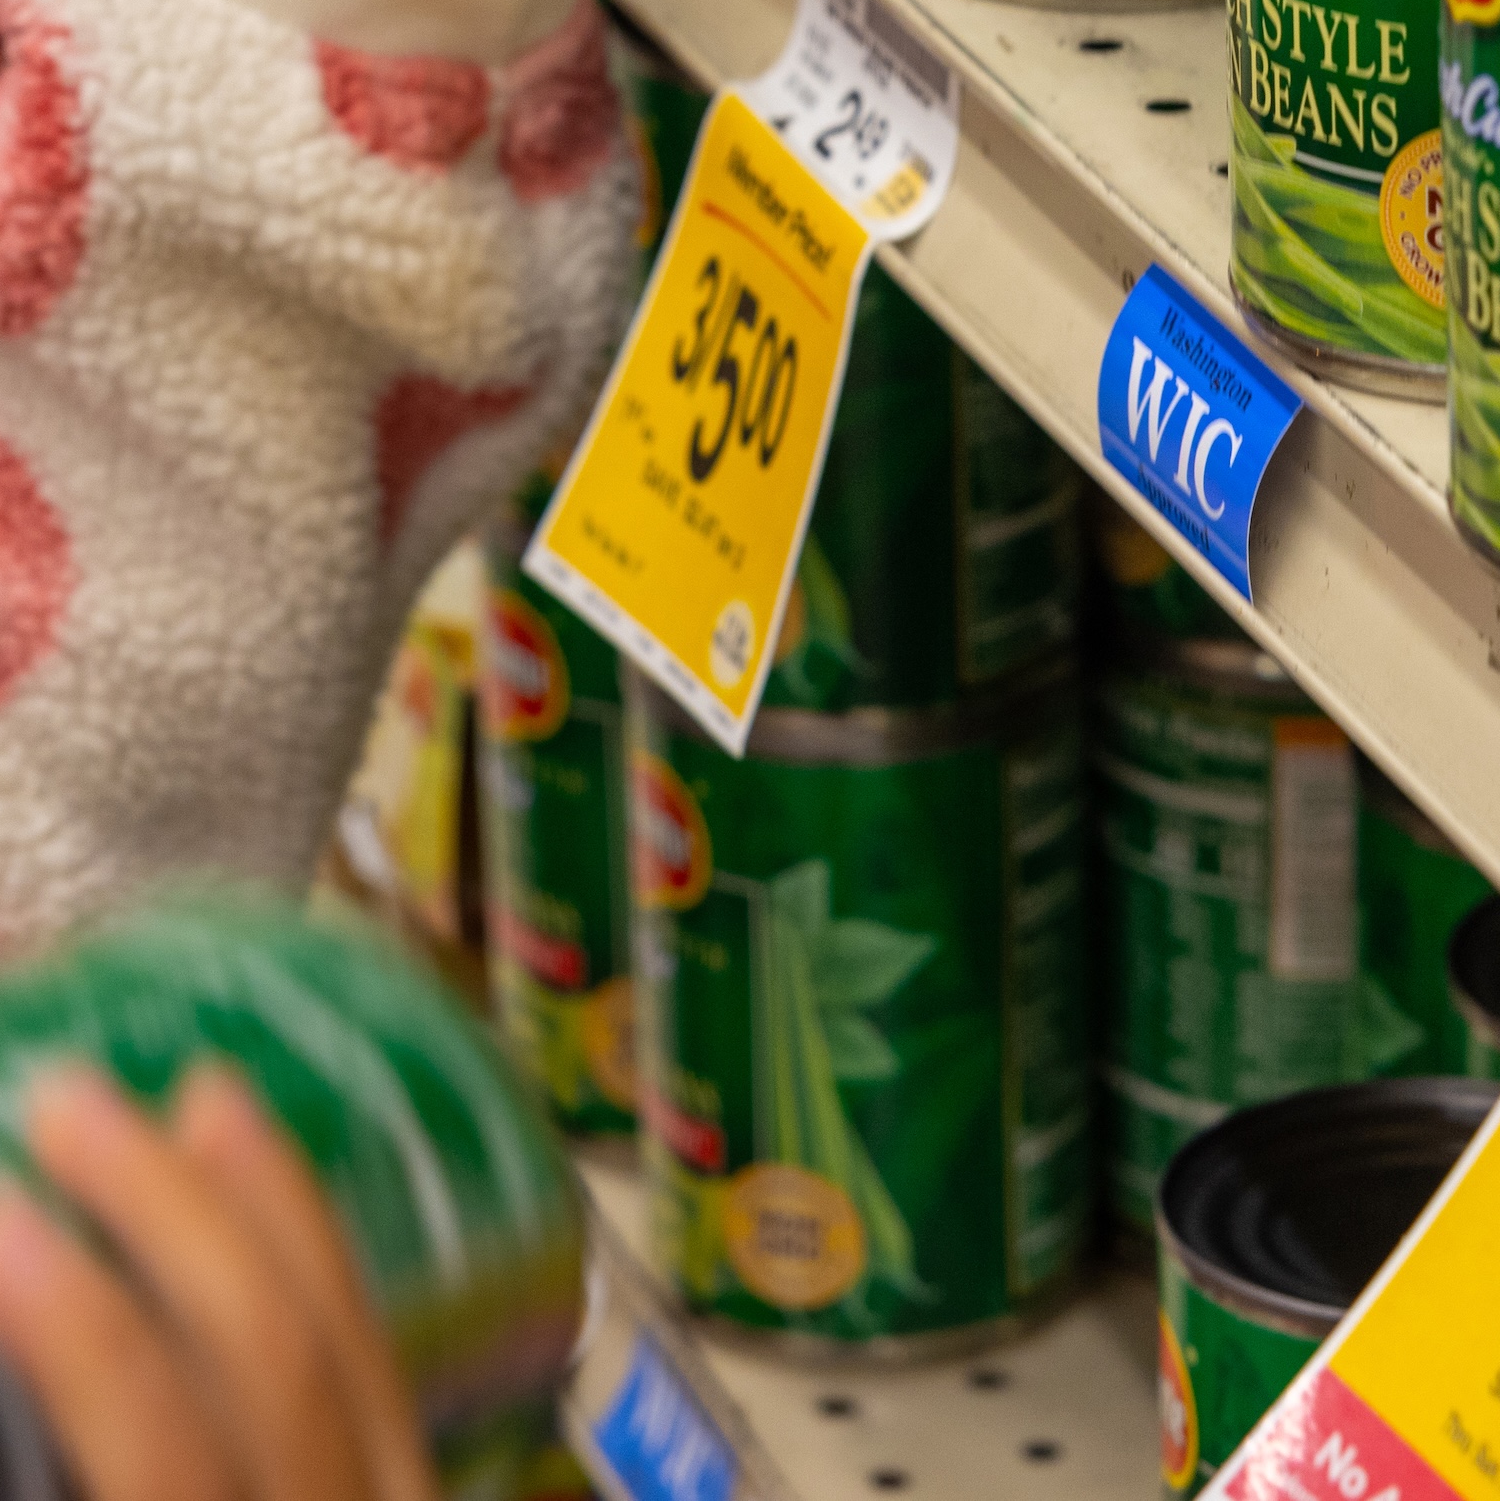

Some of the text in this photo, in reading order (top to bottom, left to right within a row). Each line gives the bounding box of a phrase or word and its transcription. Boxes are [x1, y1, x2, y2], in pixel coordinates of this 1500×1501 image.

[1247, 36, 1399, 159] BEANS
[1159, 305, 1254, 414] Washington
[1127, 335, 1244, 522] WIC
[1311, 1429, 1370, 1498] No
